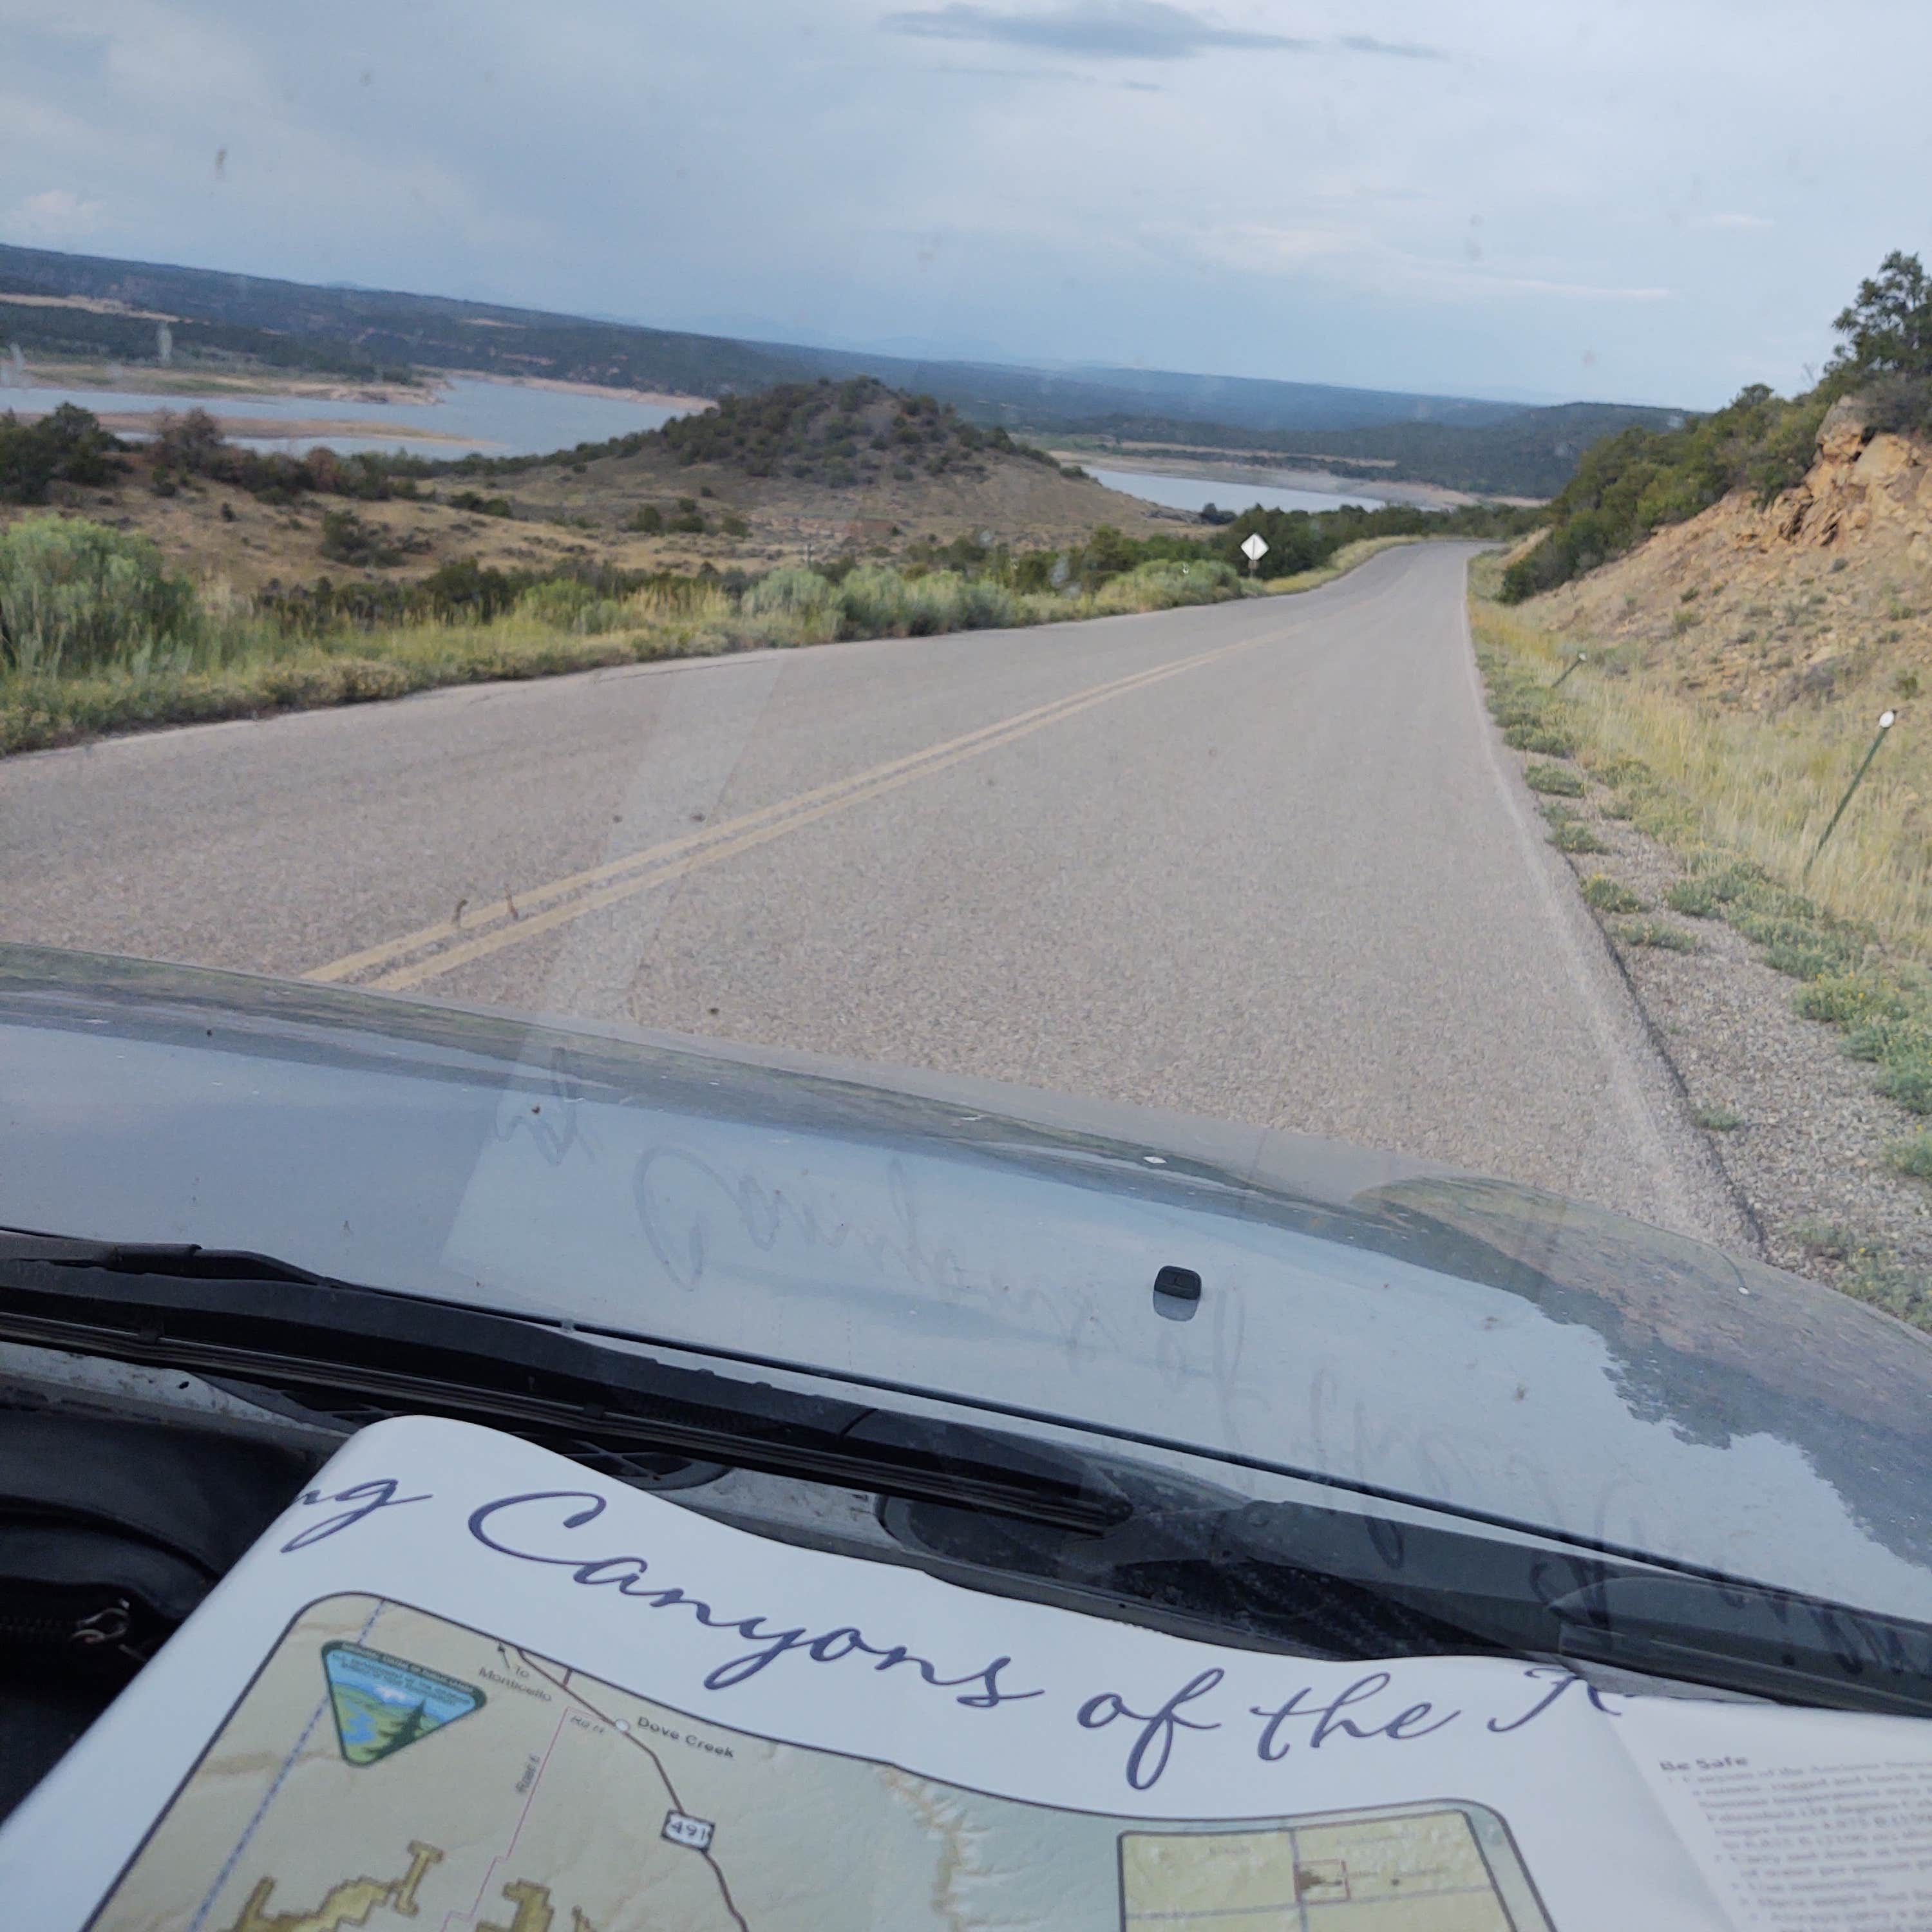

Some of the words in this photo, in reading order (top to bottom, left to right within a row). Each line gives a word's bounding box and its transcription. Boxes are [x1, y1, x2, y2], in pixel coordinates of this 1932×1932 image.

[468, 1491, 1045, 1708] Canyons
[1077, 1668, 1224, 1790] of
[1250, 1672, 1461, 1761] the
[478, 1666, 552, 1702] Monticello
[638, 1716, 680, 1740] Dove
[685, 1734, 734, 1758] Creek
[670, 1821, 707, 1841] 491
